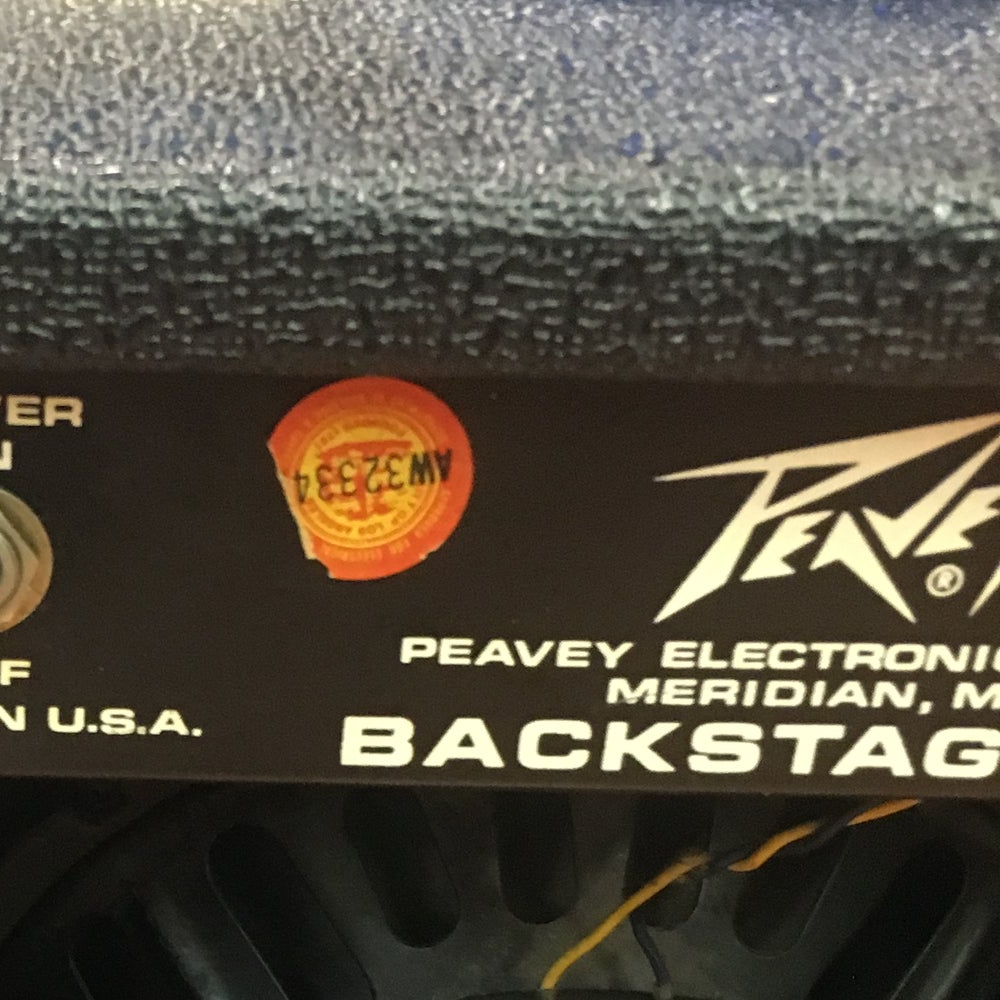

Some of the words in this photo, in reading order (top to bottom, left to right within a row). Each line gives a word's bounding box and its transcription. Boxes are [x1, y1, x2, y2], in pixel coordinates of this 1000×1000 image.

[400, 636, 634, 669] PEAVEY
[606, 678, 935, 716] MERIDIAN,
[47, 706, 203, 737] U.S.A.
